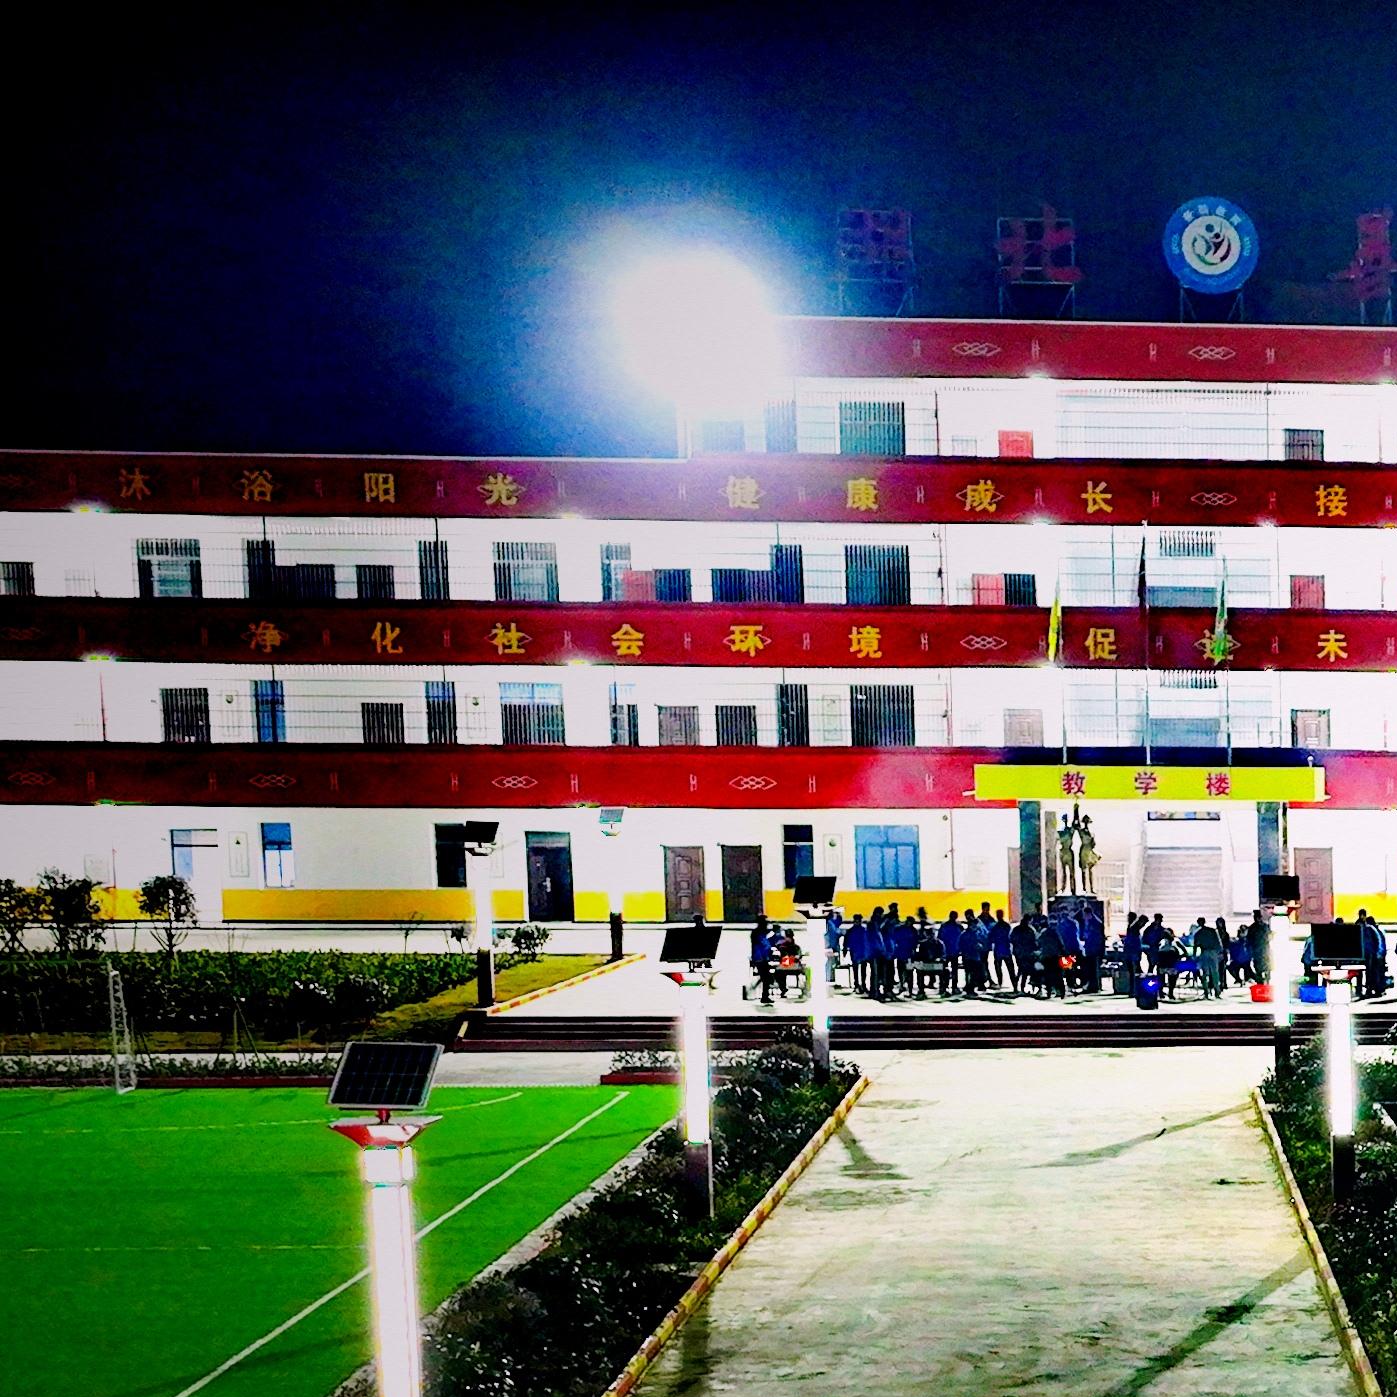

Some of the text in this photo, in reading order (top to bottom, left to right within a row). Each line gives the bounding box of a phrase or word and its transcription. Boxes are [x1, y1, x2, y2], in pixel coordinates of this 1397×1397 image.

[118, 467, 520, 506] 沐浴阳光
[726, 473, 1114, 515] 健康成长
[249, 621, 883, 658] 净化社会环境
[1061, 770, 1231, 797] 教学楼
